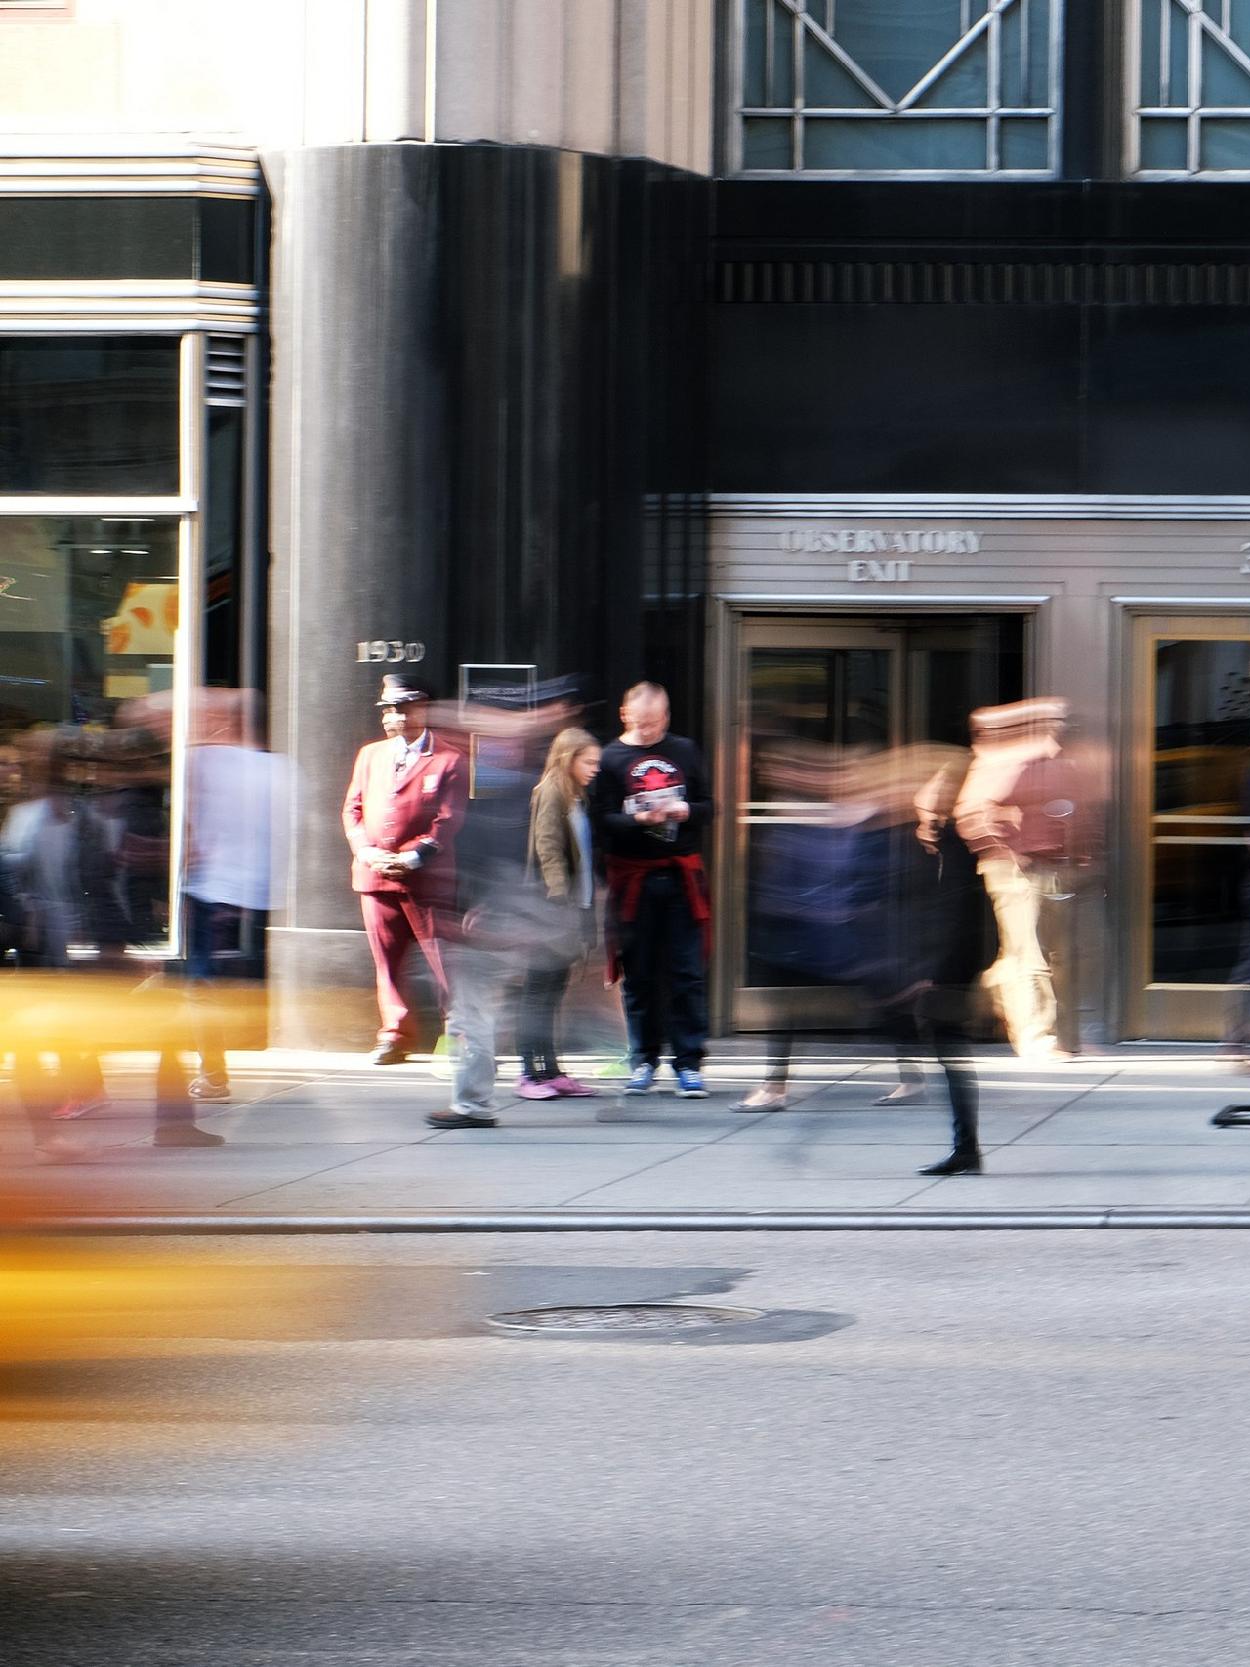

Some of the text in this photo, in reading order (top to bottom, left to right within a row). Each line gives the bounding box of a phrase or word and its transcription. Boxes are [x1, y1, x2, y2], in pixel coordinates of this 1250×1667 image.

[781, 530, 983, 553] OBSERVATORY
[848, 560, 912, 582] EXIT
[355, 640, 426, 663] 1930
